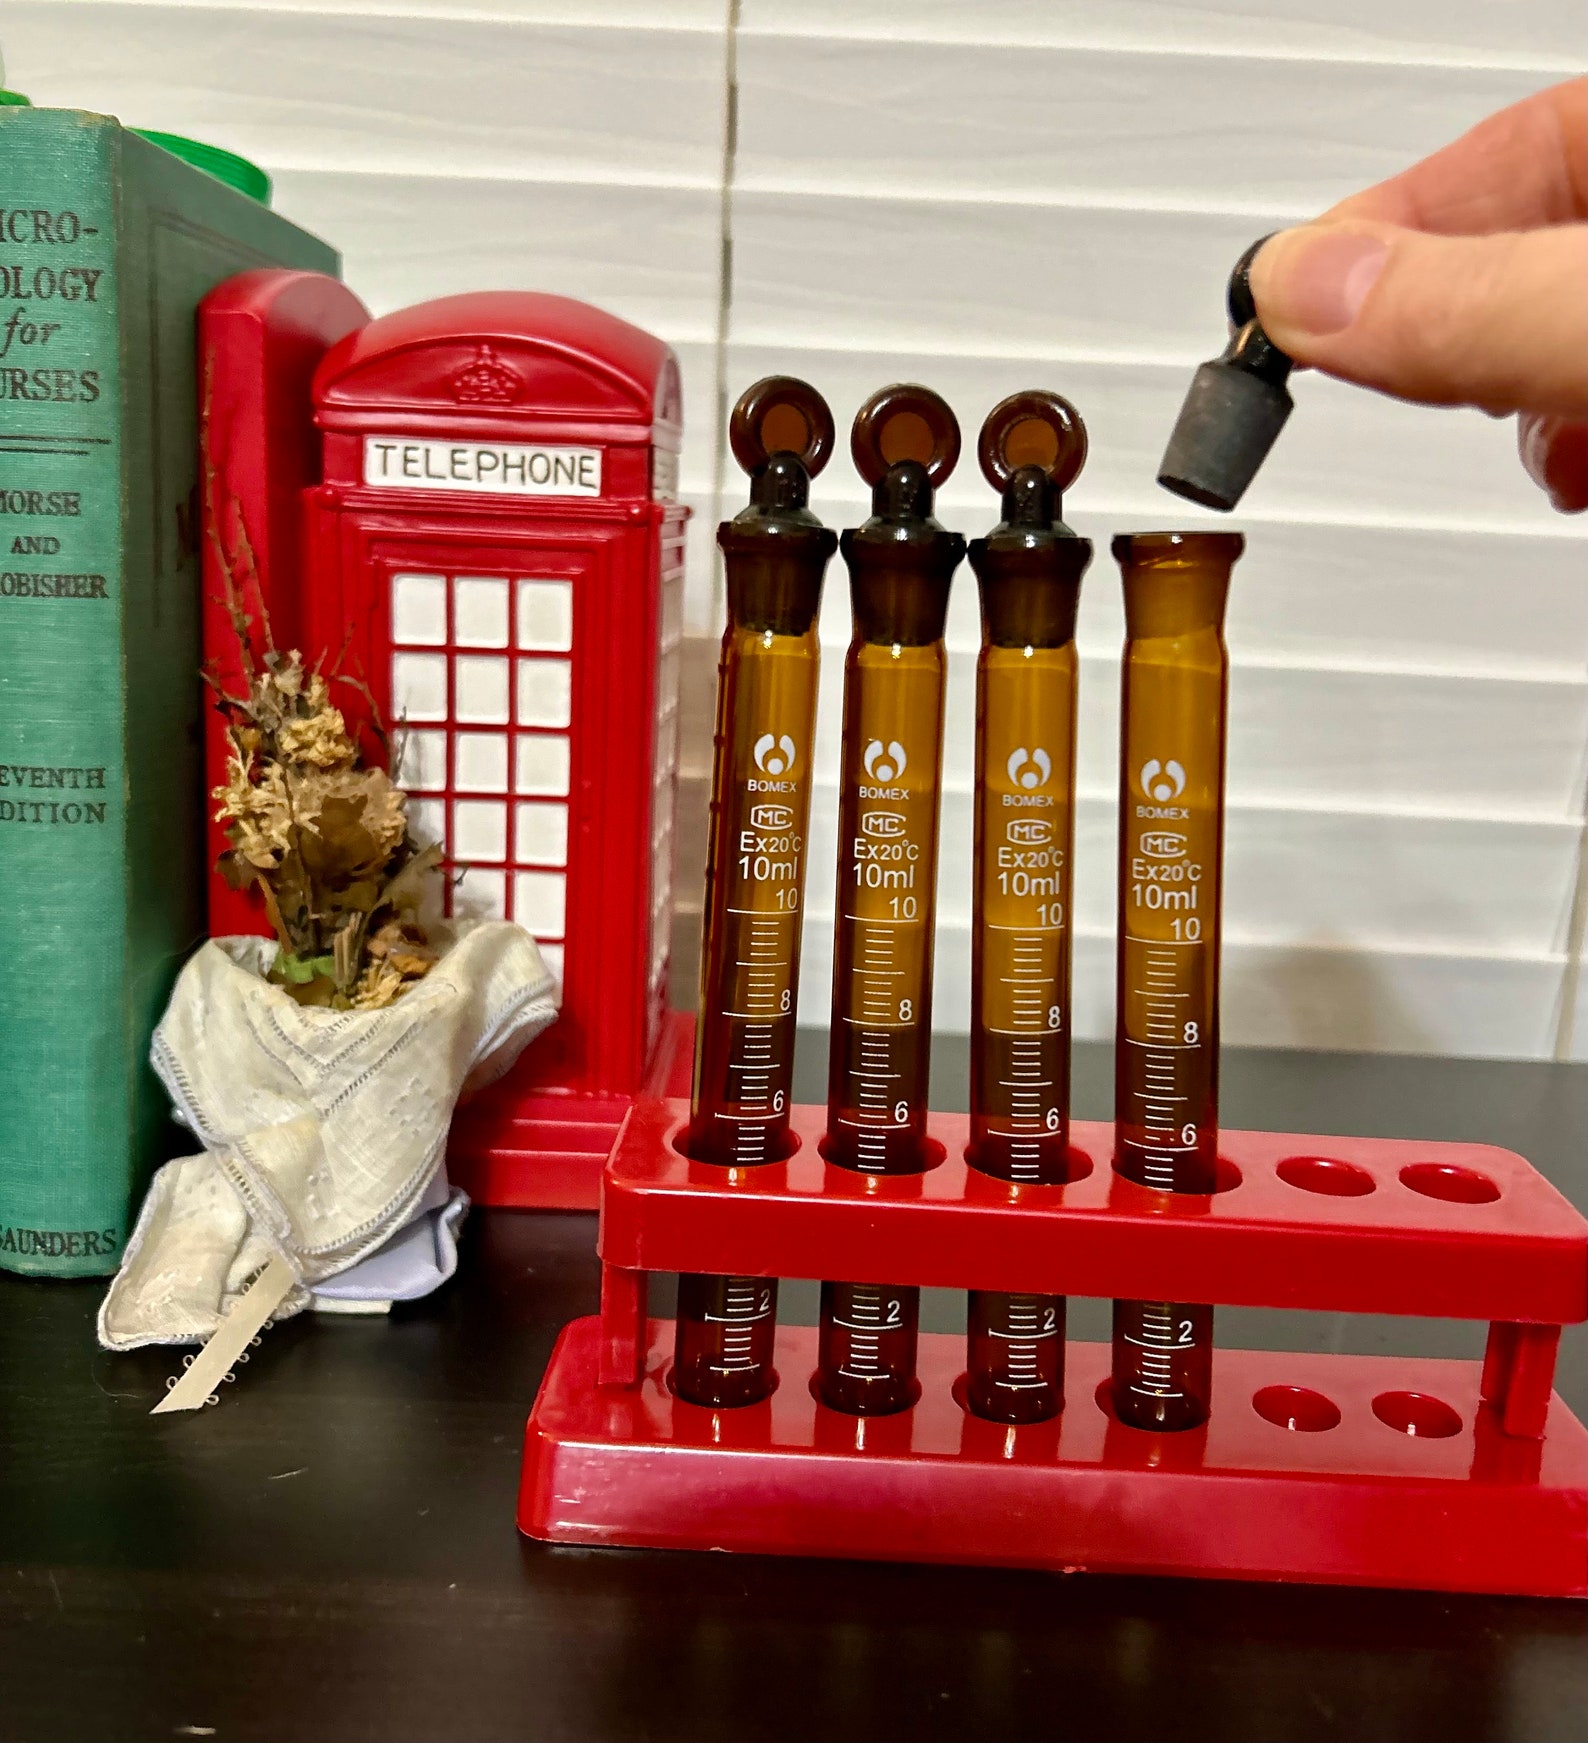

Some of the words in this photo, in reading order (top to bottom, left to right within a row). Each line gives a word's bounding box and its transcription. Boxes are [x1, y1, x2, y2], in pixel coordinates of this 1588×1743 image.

[0, 306, 60, 359] for
[374, 444, 598, 489] TELEPHONE
[10, 536, 61, 555] AND
[747, 778, 797, 793] BOMEX
[858, 785, 910, 801] BOMEX
[1002, 794, 1053, 807] BOMEX
[1135, 805, 1190, 820] BOMEX
[738, 855, 798, 881] 10ml
[853, 862, 915, 889] 10ml
[997, 871, 1060, 897] 10ml
[775, 887, 798, 910] 10
[889, 896, 917, 919] 10
[1132, 883, 1198, 910] 10ml
[1036, 902, 1063, 926] 10
[1170, 917, 1201, 940] 10
[779, 989, 792, 1012] 8
[898, 998, 913, 1021] 8
[1047, 1005, 1061, 1029] 8
[1183, 1021, 1199, 1044] 8
[772, 1090, 785, 1112] 6
[894, 1100, 909, 1123] 6
[1045, 1109, 1060, 1130] 6
[1180, 1123, 1197, 1146] 6
[0, 1225, 117, 1258] AUNDERS
[759, 1289, 771, 1313] 2
[886, 1300, 901, 1323] 2
[1043, 1308, 1056, 1331] 2
[1178, 1320, 1194, 1343] 2
